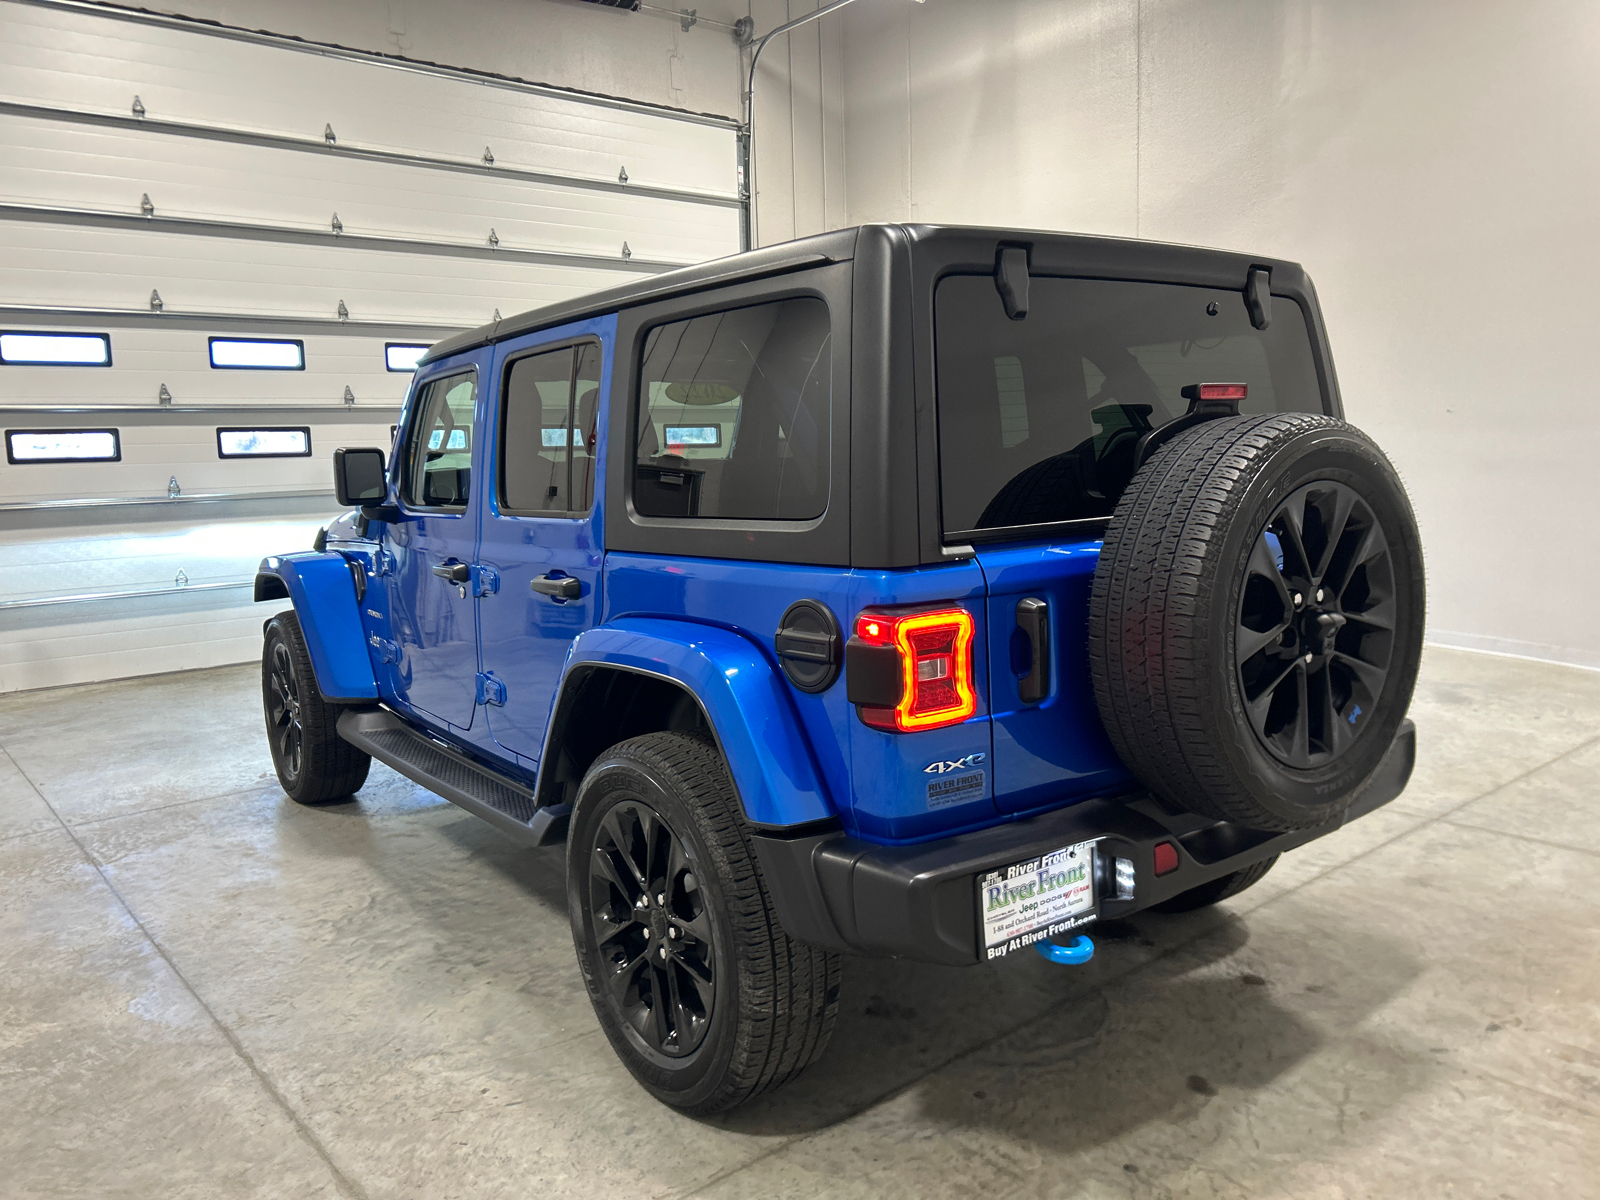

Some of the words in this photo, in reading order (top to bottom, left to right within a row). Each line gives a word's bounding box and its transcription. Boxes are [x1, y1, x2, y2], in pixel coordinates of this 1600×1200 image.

[928, 779, 954, 792] RIVER
[956, 773, 983, 786] FRONT
[1007, 860, 1040, 880] River
[1019, 901, 1039, 914] Jeep
[1036, 906, 1050, 918] Road
[1052, 901, 1067, 913] North
[987, 941, 1009, 960] Buy
[1009, 939, 1022, 952] At
[1021, 928, 1048, 947] River
[1048, 914, 1097, 936] Front.com
